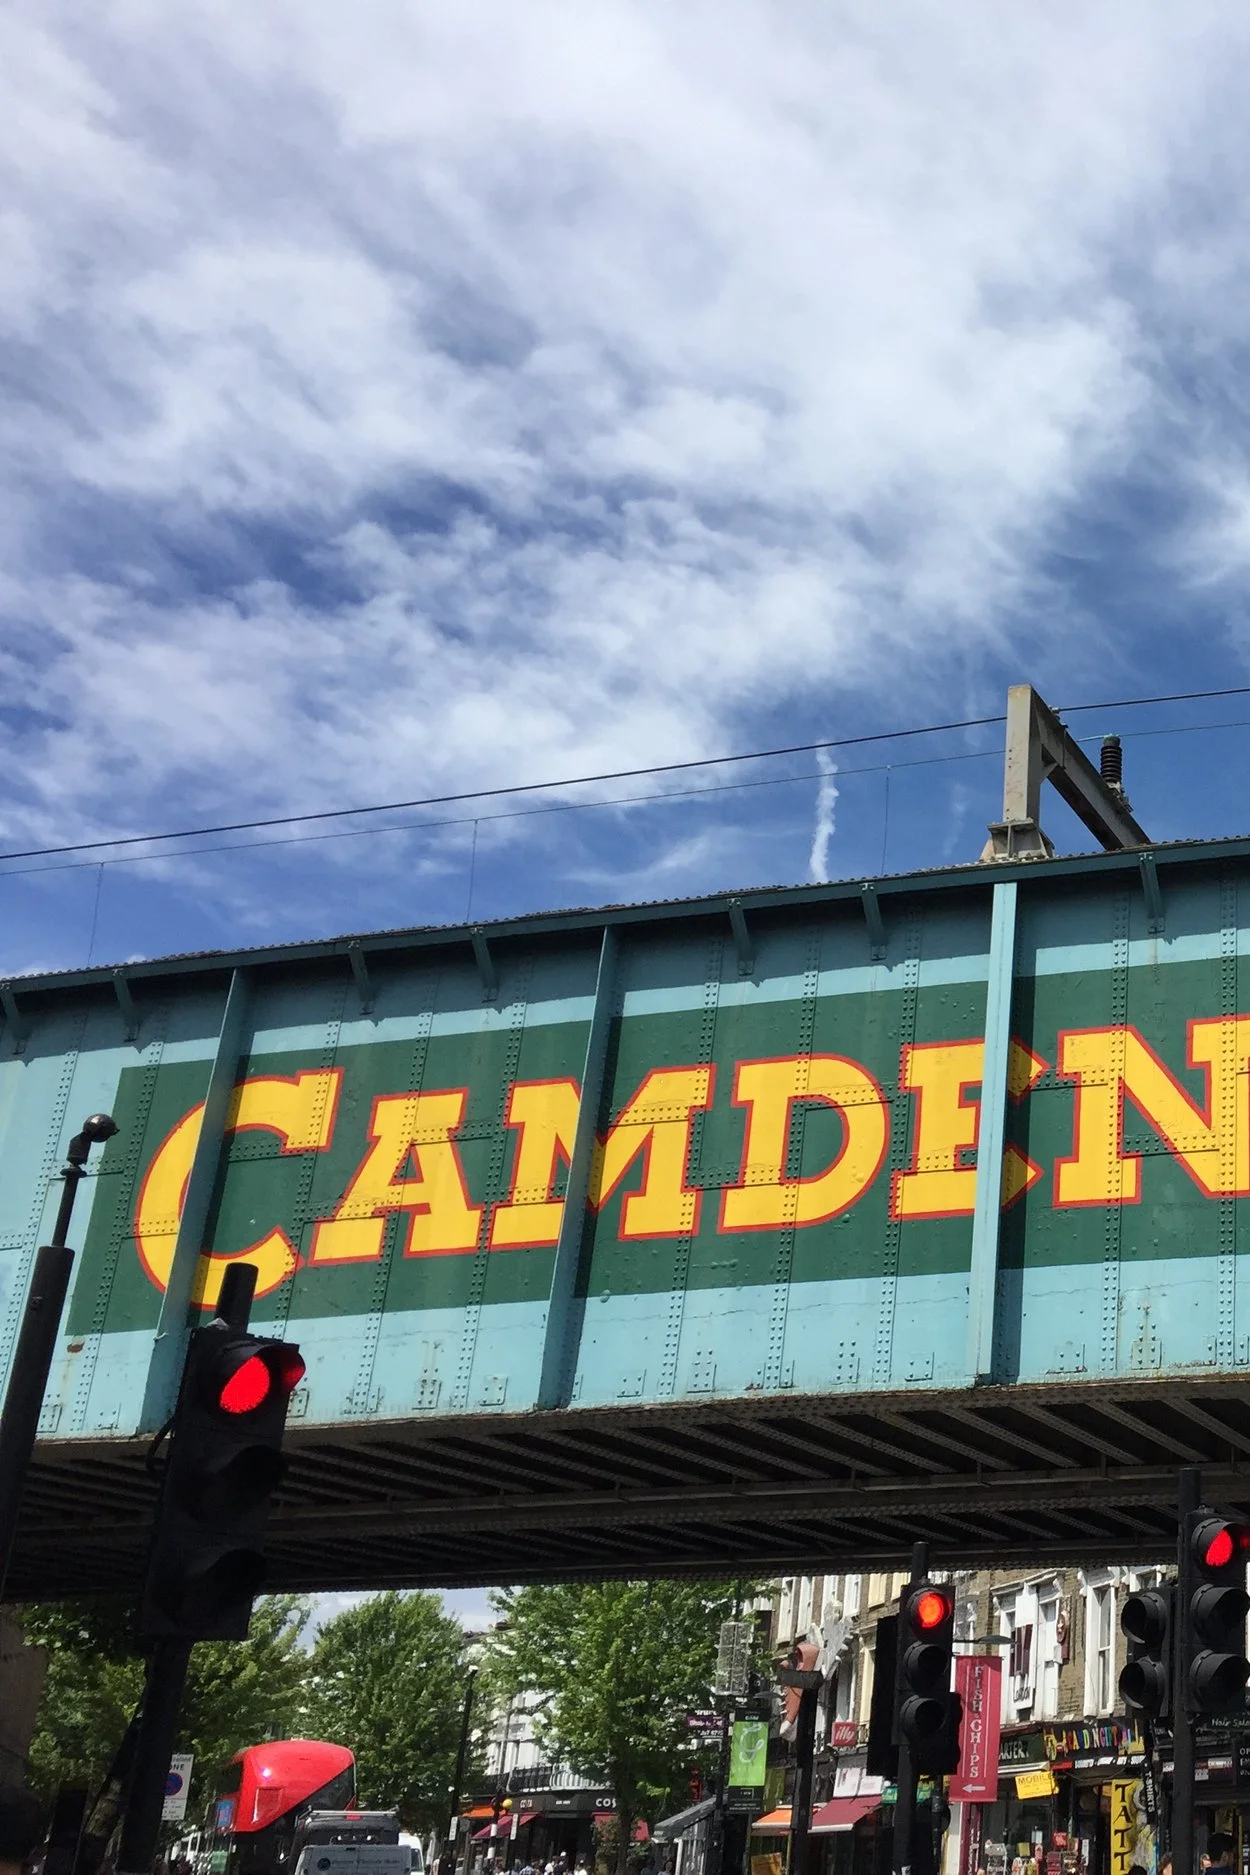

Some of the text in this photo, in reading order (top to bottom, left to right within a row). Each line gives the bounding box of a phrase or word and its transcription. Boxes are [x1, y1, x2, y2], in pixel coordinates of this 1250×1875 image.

[973, 1665, 984, 1713] FISH
[835, 1726, 855, 1743] illy
[969, 1719, 983, 1779] CHIPS
[1112, 1781, 1134, 1875] TATT
